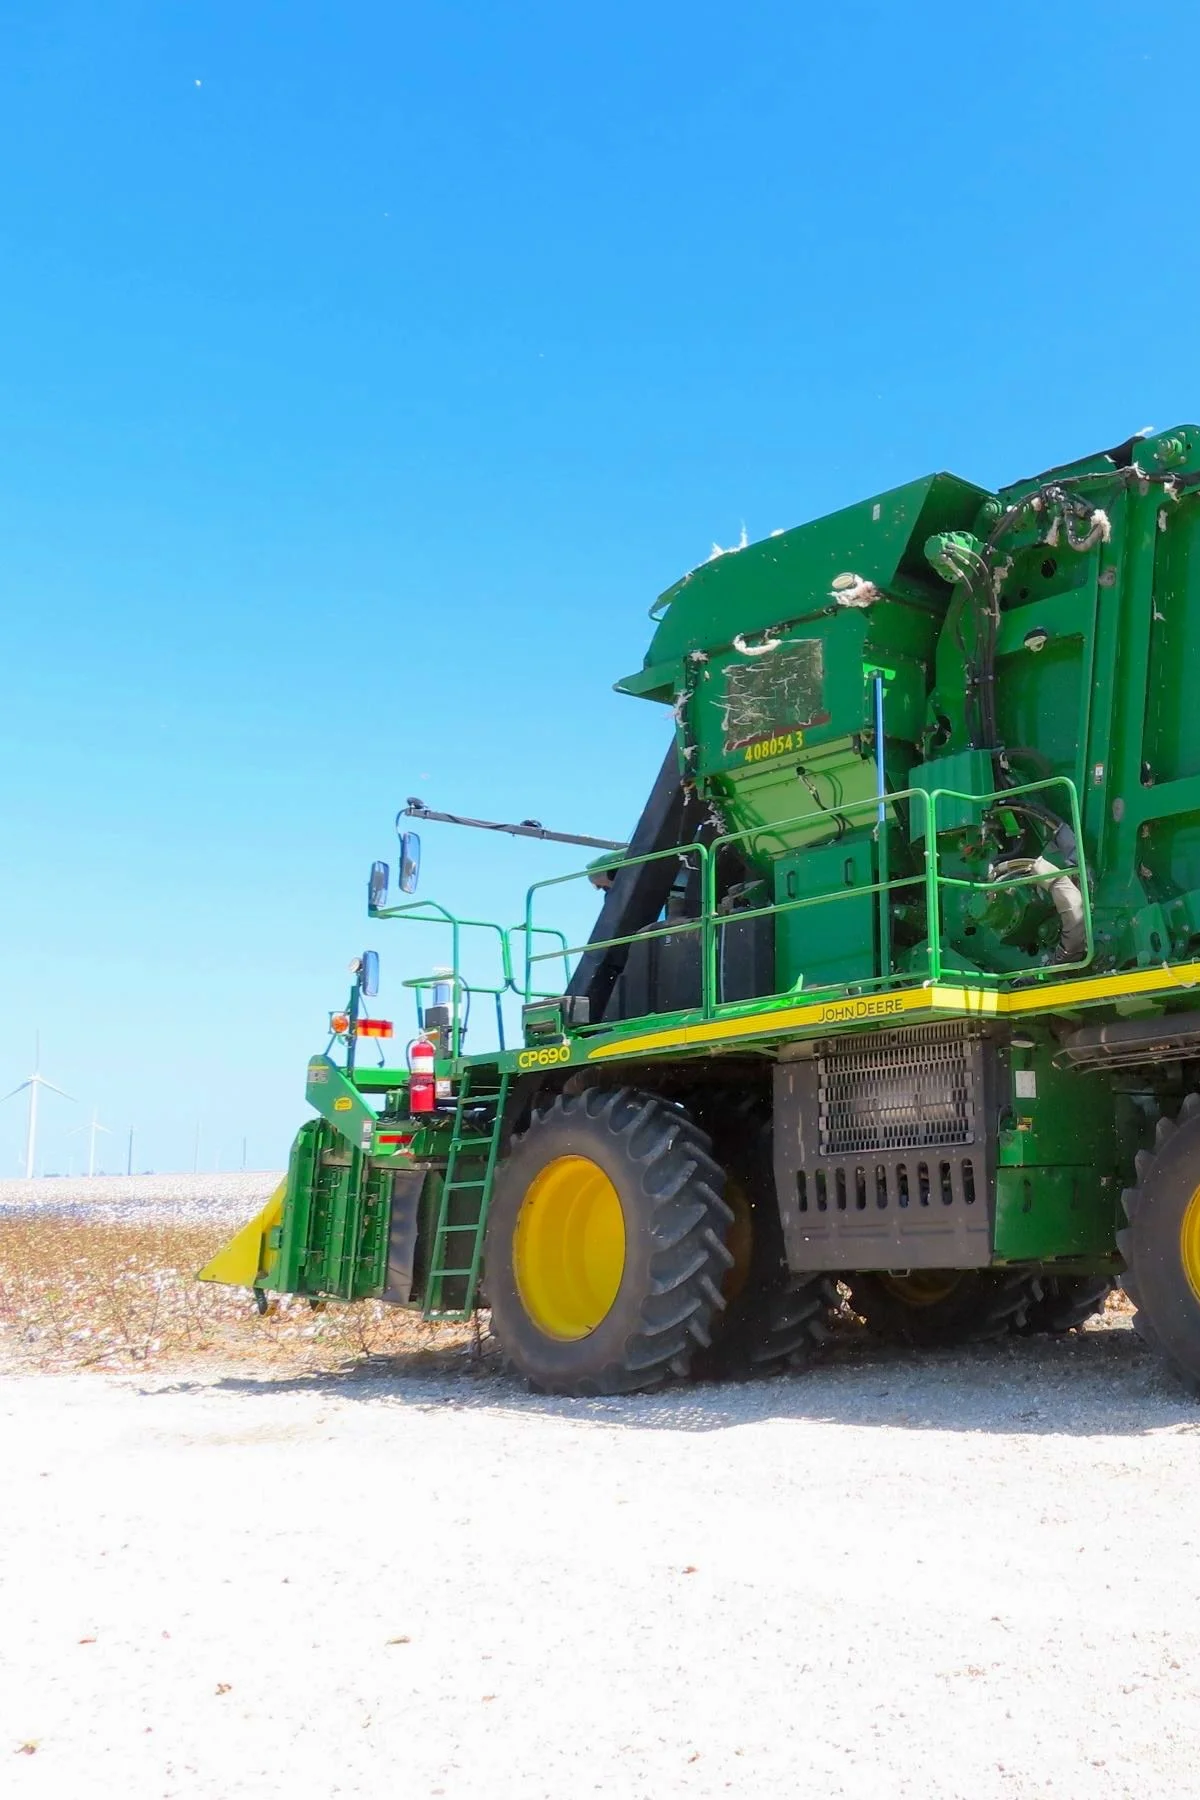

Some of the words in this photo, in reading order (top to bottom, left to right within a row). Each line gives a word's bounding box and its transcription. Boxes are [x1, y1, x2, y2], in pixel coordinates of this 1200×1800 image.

[818, 1006, 855, 1021] JOHN
[856, 999, 903, 1016] DEERE
[519, 1045, 571, 1068] CP690
